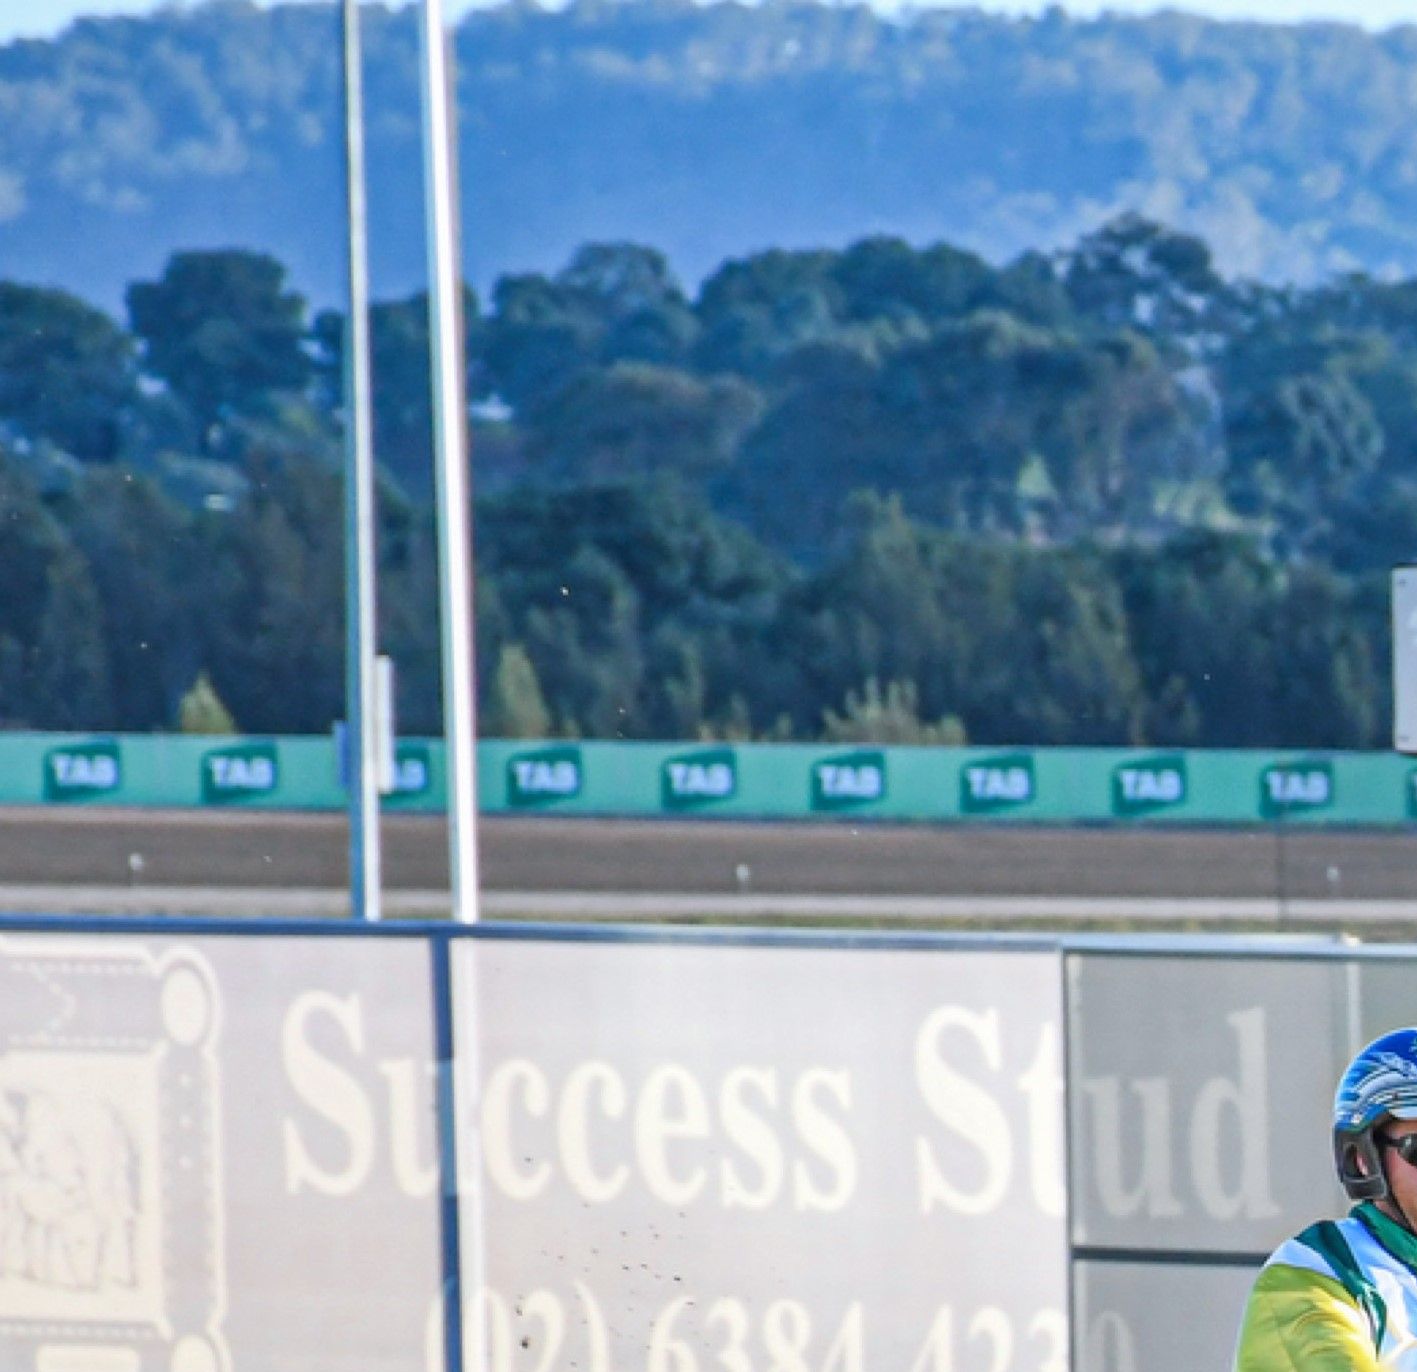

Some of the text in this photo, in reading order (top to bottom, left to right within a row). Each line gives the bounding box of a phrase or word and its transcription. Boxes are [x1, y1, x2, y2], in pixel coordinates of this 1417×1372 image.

[54, 754, 117, 787] TAB
[211, 756, 274, 788] TAB
[515, 761, 577, 791] TAB
[669, 763, 732, 794] TAB
[820, 766, 880, 796] TAB
[968, 767, 1029, 799] TAB
[1120, 770, 1180, 800] TAB
[1269, 772, 1328, 802] TAB
[283, 989, 1280, 1221] Success Stud
